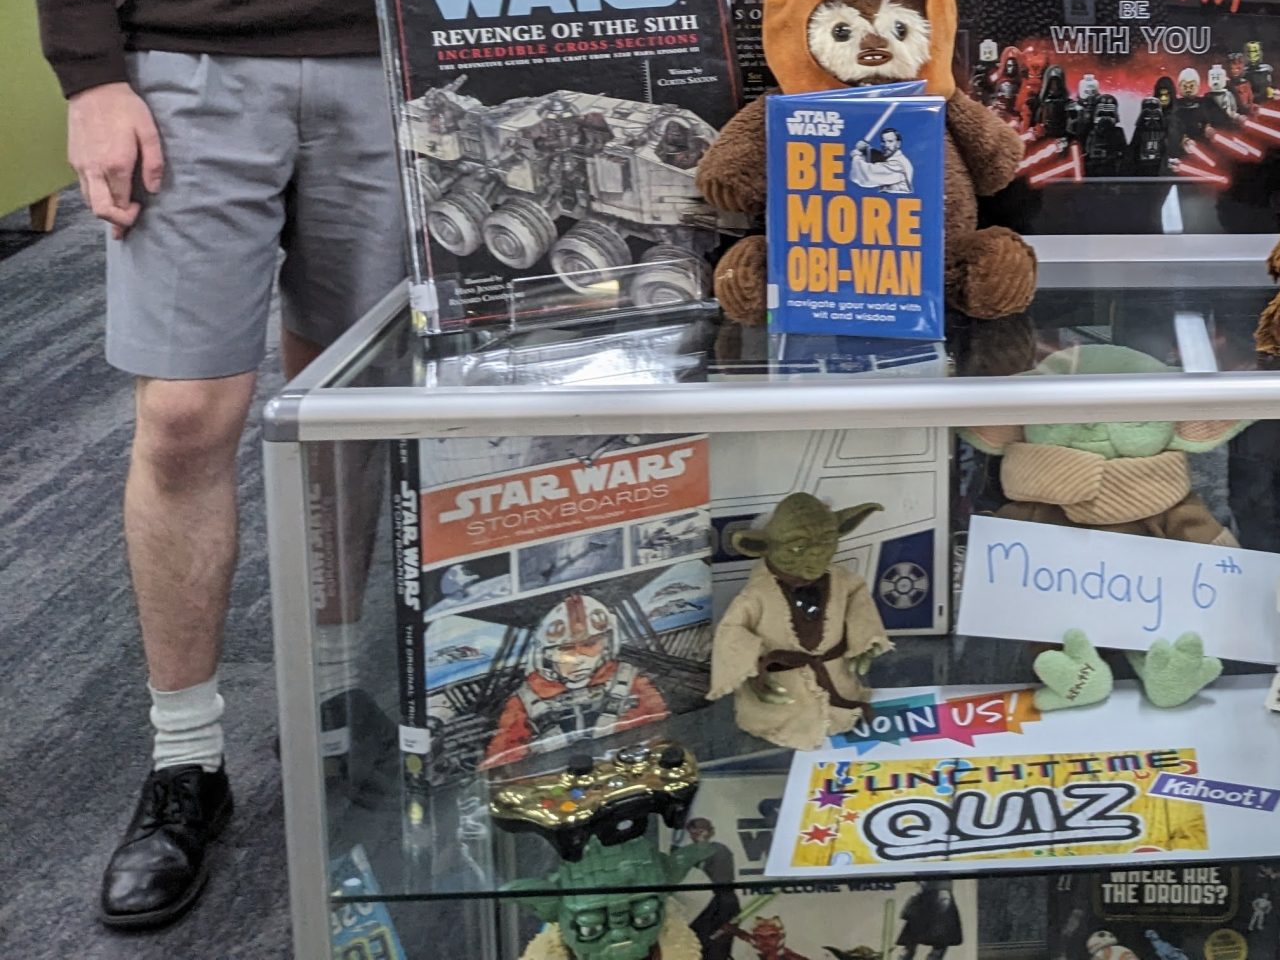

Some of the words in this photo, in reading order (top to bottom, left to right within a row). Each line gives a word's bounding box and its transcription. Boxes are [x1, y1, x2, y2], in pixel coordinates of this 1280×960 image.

[1118, 0, 1150, 19] BE
[432, 24, 546, 47] REVENGE
[551, 20, 584, 40] OF
[588, 17, 639, 38] THE
[644, 14, 699, 33] SITH
[437, 43, 548, 61] INCREDIBLE
[554, 33, 699, 54] CROSS-SECTIONS
[1050, 26, 1130, 55] WITH
[1140, 26, 1212, 55] YOU
[786, 110, 844, 124] STAR
[787, 123, 845, 137] WARS
[786, 141, 845, 191] BE
[787, 193, 922, 247] MORE
[787, 245, 922, 297] OBI-WAN
[786, 299, 836, 310] navigate
[838, 302, 864, 311] your
[867, 302, 897, 311] world
[899, 303, 922, 311] with
[812, 311, 828, 319] wit
[830, 312, 853, 320] and
[855, 313, 896, 322] wisdom
[439, 474, 570, 524] STAR
[570, 448, 694, 495] WARS
[401, 481, 419, 546] STAR
[466, 484, 670, 536] STORYBOARDS
[403, 547, 421, 611] WARS
[987, 541, 1163, 632] Monday
[853, 709, 935, 738] JOIN
[950, 692, 1018, 728] US!
[824, 750, 1184, 796] LUNCHTIME
[1162, 777, 1270, 810] Kahoot!
[862, 782, 1142, 857] QUIZ
[1102, 884, 1139, 904] THE
[1144, 884, 1229, 906] DROIDS?
[1110, 868, 1177, 884] WHERE
[1183, 867, 1221, 884] ARE
